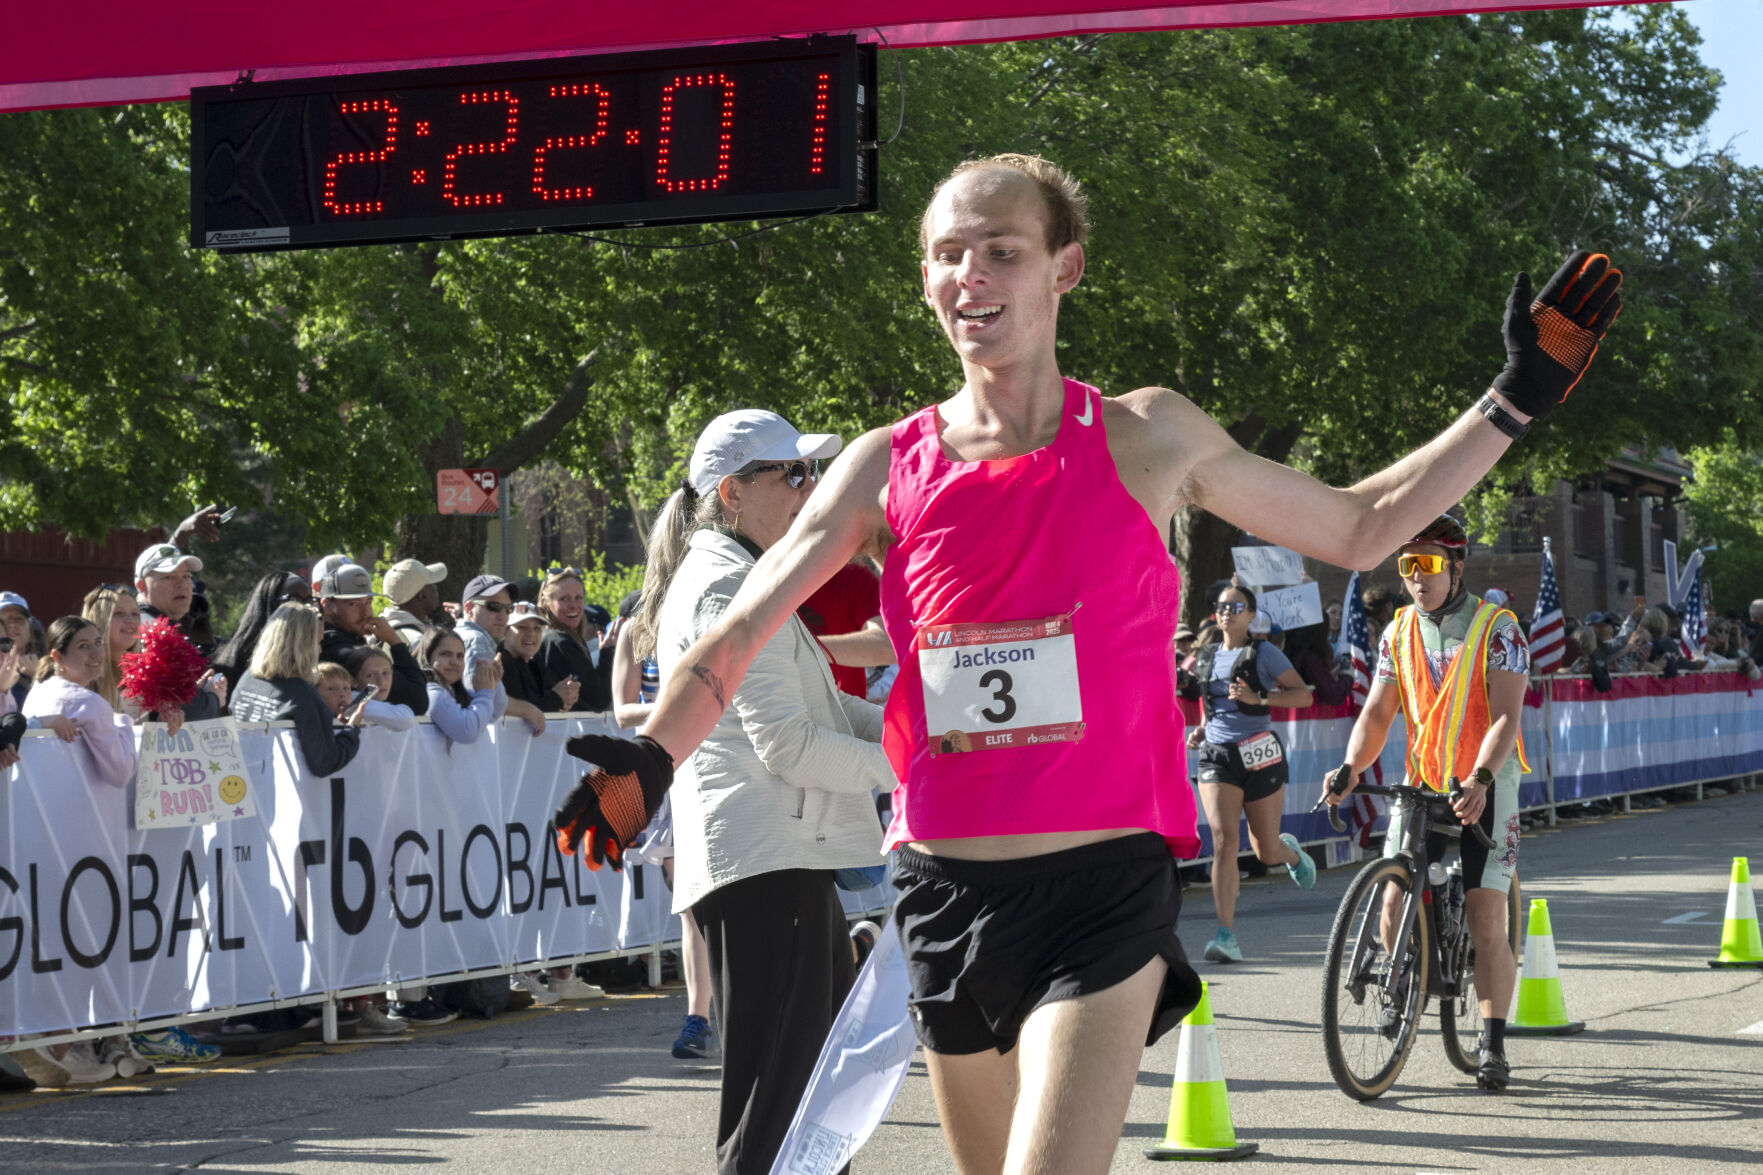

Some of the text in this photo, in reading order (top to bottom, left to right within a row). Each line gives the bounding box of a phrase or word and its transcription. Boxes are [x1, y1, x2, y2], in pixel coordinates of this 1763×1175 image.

[443, 486, 472, 506] 24
[954, 626, 1032, 637] LINCOLN MARATHON
[991, 631, 1033, 640] MARATHON
[953, 647, 1035, 669] Jackson
[979, 669, 1017, 723] 3
[985, 734, 1013, 746] ELITE
[1027, 733, 1067, 744] rb GLOBAL
[1243, 740, 1279, 765] 3967
[160, 784, 214, 817] RUN!
[295, 778, 375, 942] rb
[389, 820, 597, 930] GLOBAL
